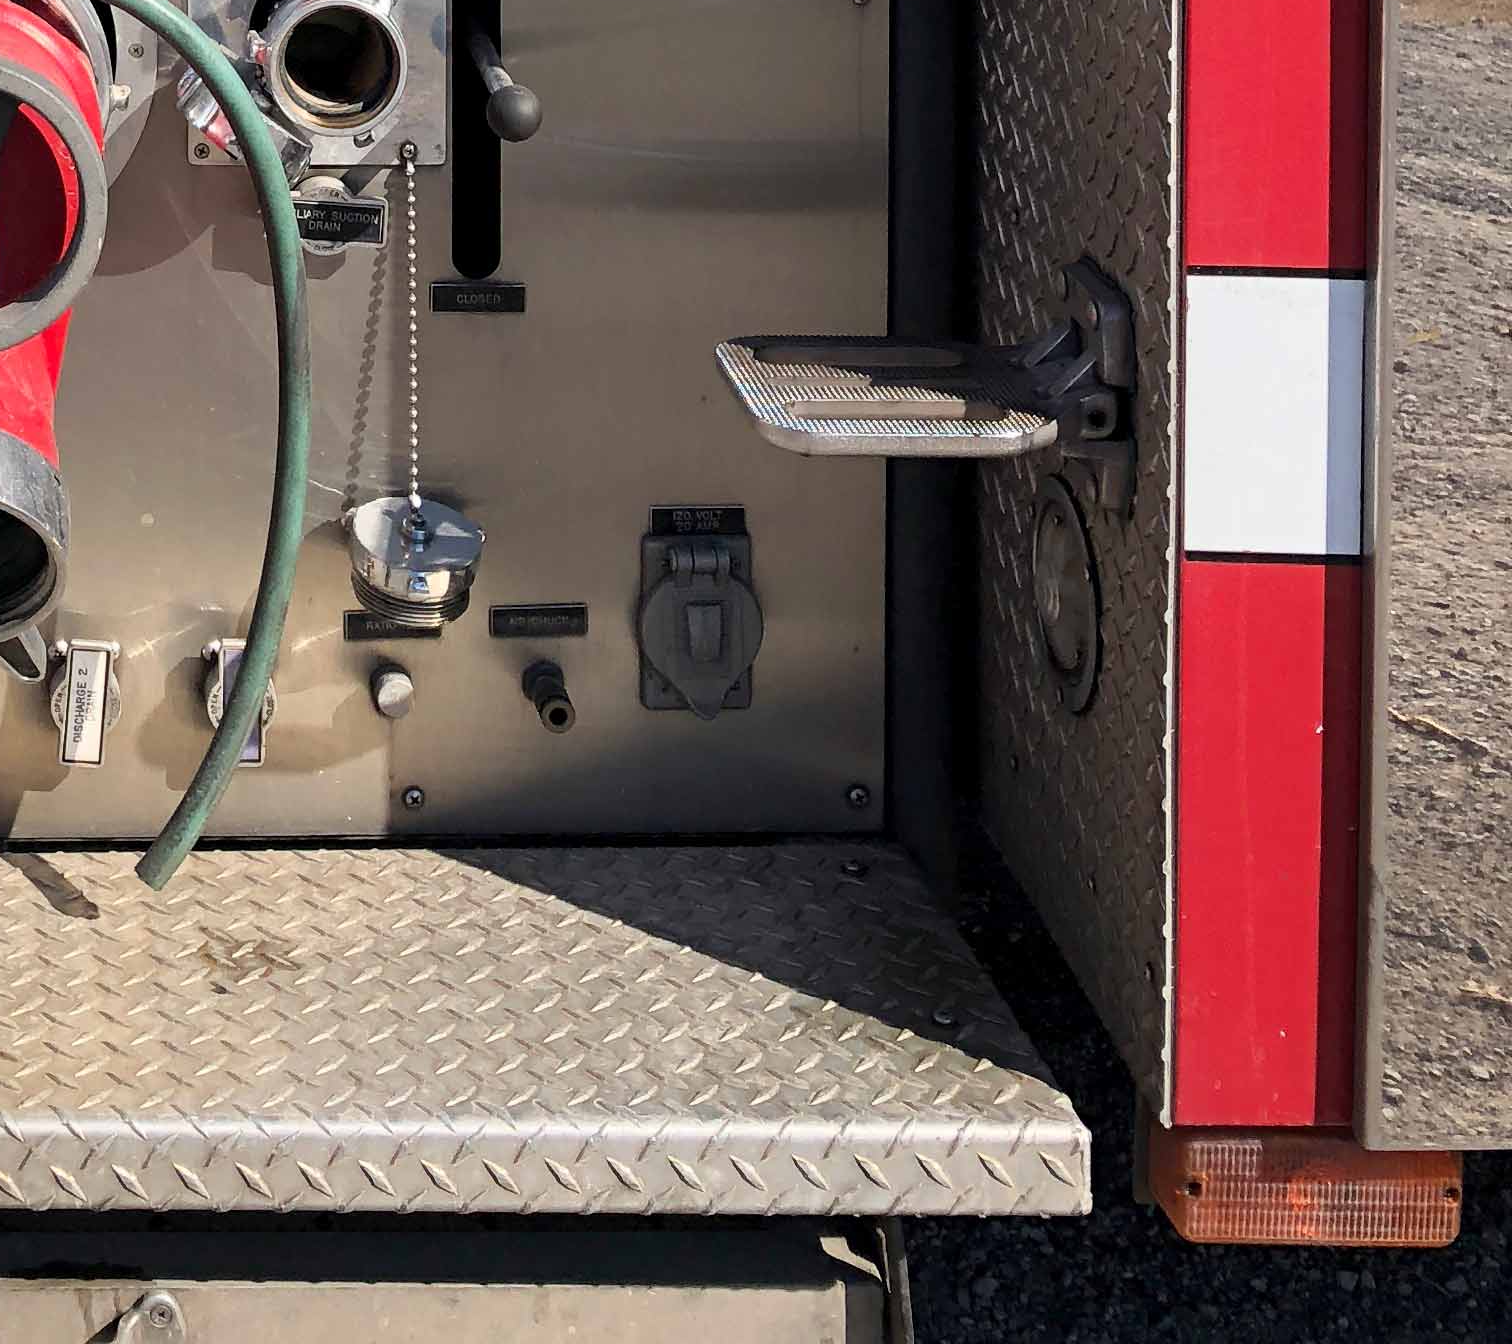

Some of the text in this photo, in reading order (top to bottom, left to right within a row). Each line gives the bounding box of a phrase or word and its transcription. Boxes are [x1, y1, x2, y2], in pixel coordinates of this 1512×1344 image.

[296, 208, 379, 225] LIARY SUCTION
[308, 220, 341, 232] DRAIN
[456, 293, 501, 305] CLOSED
[673, 511, 723, 521] 120 VOLT
[675, 521, 690, 531] 20
[72, 667, 88, 743] DISCHARGE 2
